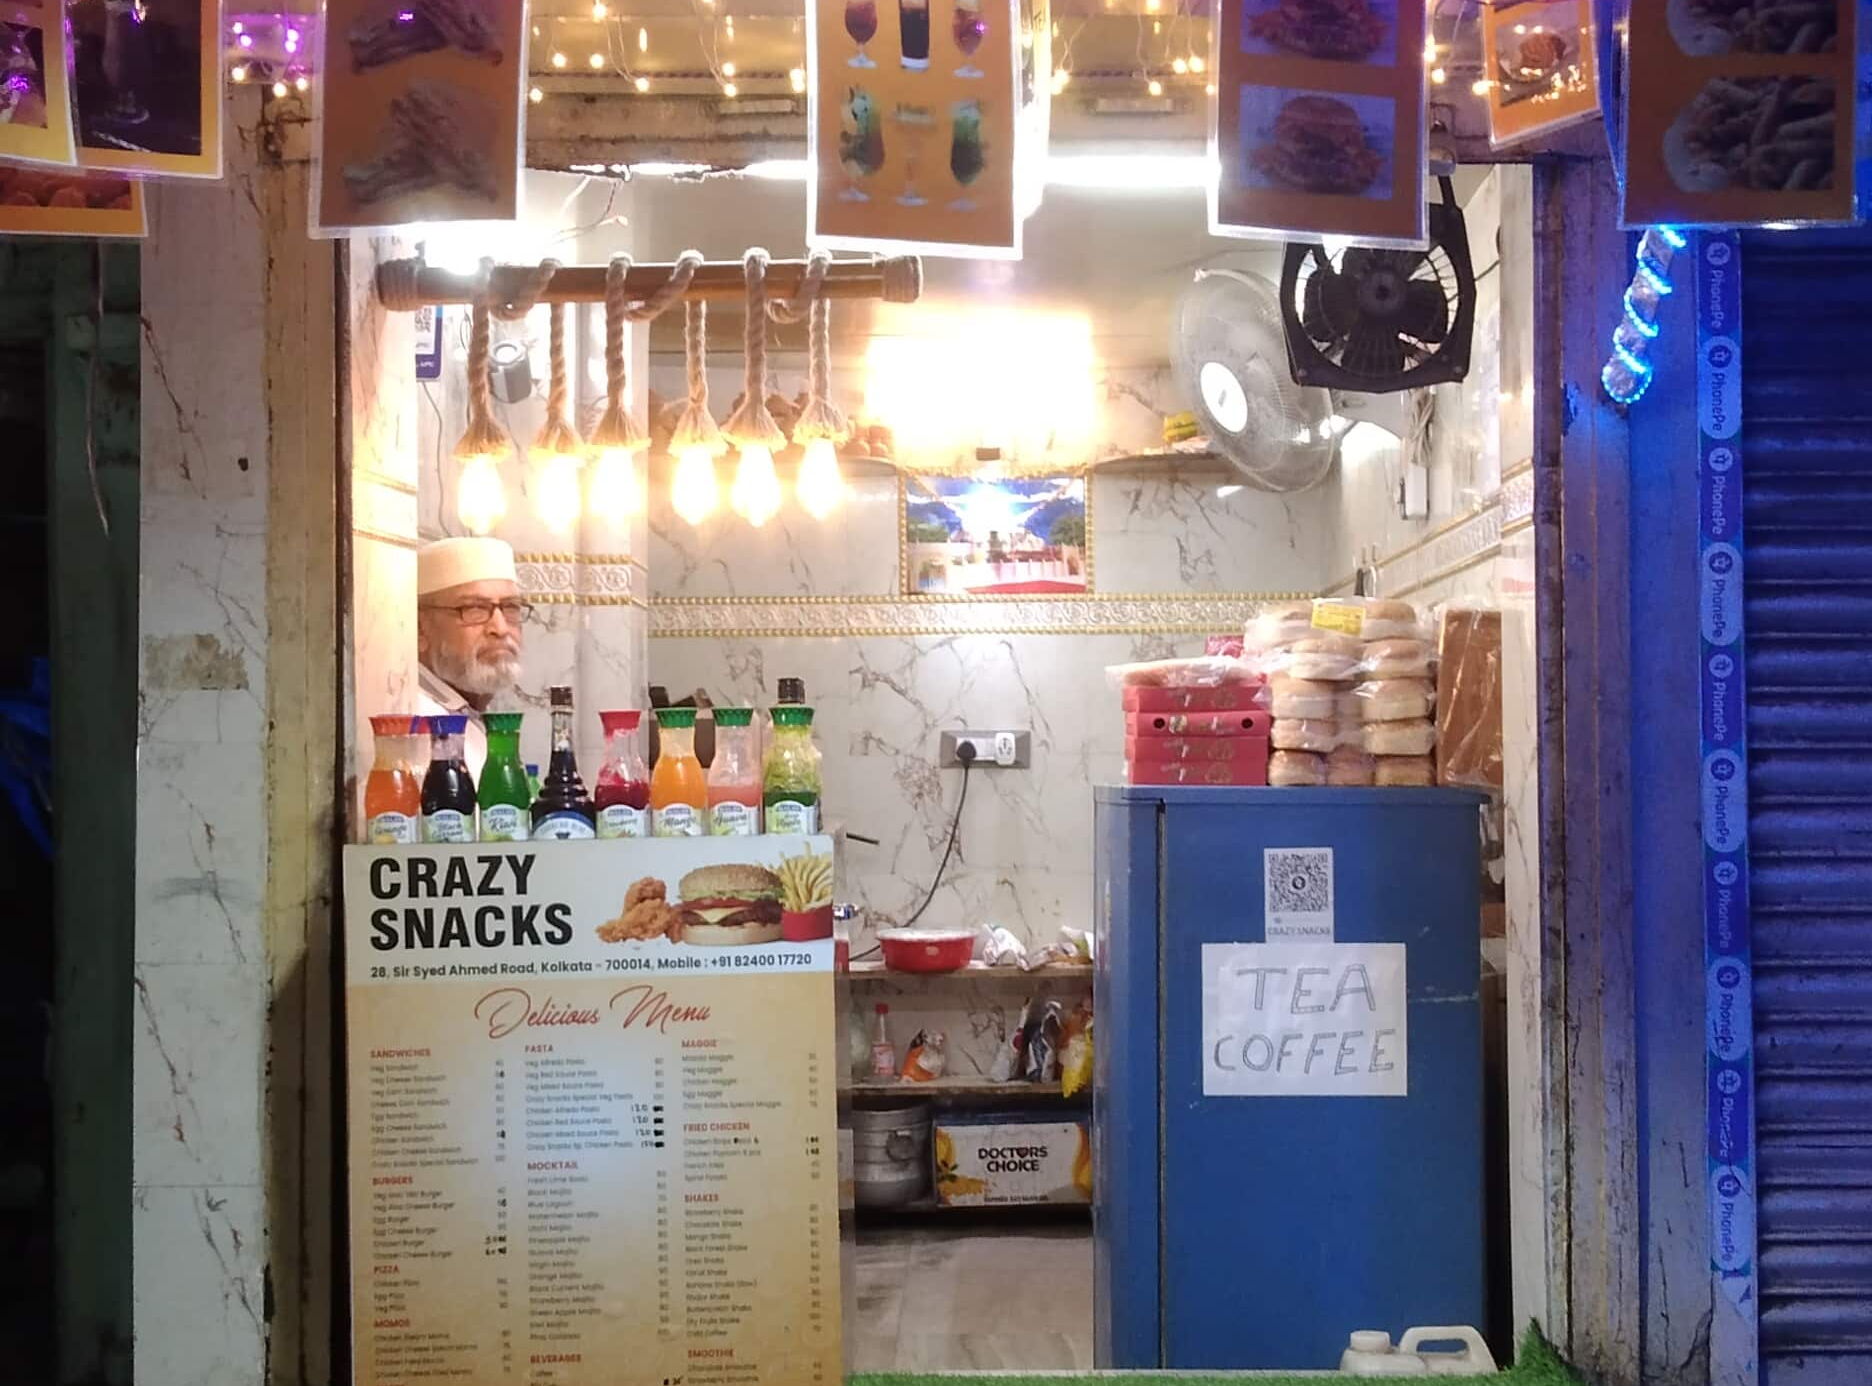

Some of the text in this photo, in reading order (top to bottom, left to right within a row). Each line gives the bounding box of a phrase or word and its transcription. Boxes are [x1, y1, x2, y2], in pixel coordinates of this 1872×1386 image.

[1709, 269, 1725, 329] PhonePe
[1710, 372, 1726, 433] PhonePe
[1710, 474, 1726, 535] PhonePe
[1710, 577, 1726, 639] PhonePe
[1712, 680, 1728, 742] PhonePe
[1714, 785, 1730, 846] PhonePe
[370, 854, 536, 900] CRAZY
[370, 903, 573, 951] SNACKS
[1717, 889, 1732, 949] PhonePe
[393, 965, 409, 977] Sir
[414, 964, 446, 980] Syed
[449, 963, 498, 975] Ahmed
[500, 962, 538, 975] Road,
[541, 960, 592, 973] Kolkata
[657, 956, 702, 969] Mobile
[711, 955, 731, 968] +91
[734, 954, 774, 967] 82400
[777, 953, 813, 966] 17720
[1236, 963, 1376, 1015] TEA
[473, 985, 711, 1039] Delicious Menu
[370, 1049, 431, 1058] SANDWICHES
[525, 1045, 553, 1053] PASTA
[682, 1039, 718, 1048] MAGGIE
[1214, 1029, 1396, 1075] COFFEE
[684, 1122, 750, 1132] FRIED CHICKEN
[372, 1175, 413, 1186] BURGERS
[986, 1159, 1040, 1173] CHOICE
[685, 1194, 719, 1202] SHAKES
[1720, 1201, 1735, 1263] PhonePe
[374, 1265, 399, 1275] PIZZA
[374, 1319, 410, 1328] MOMOS
